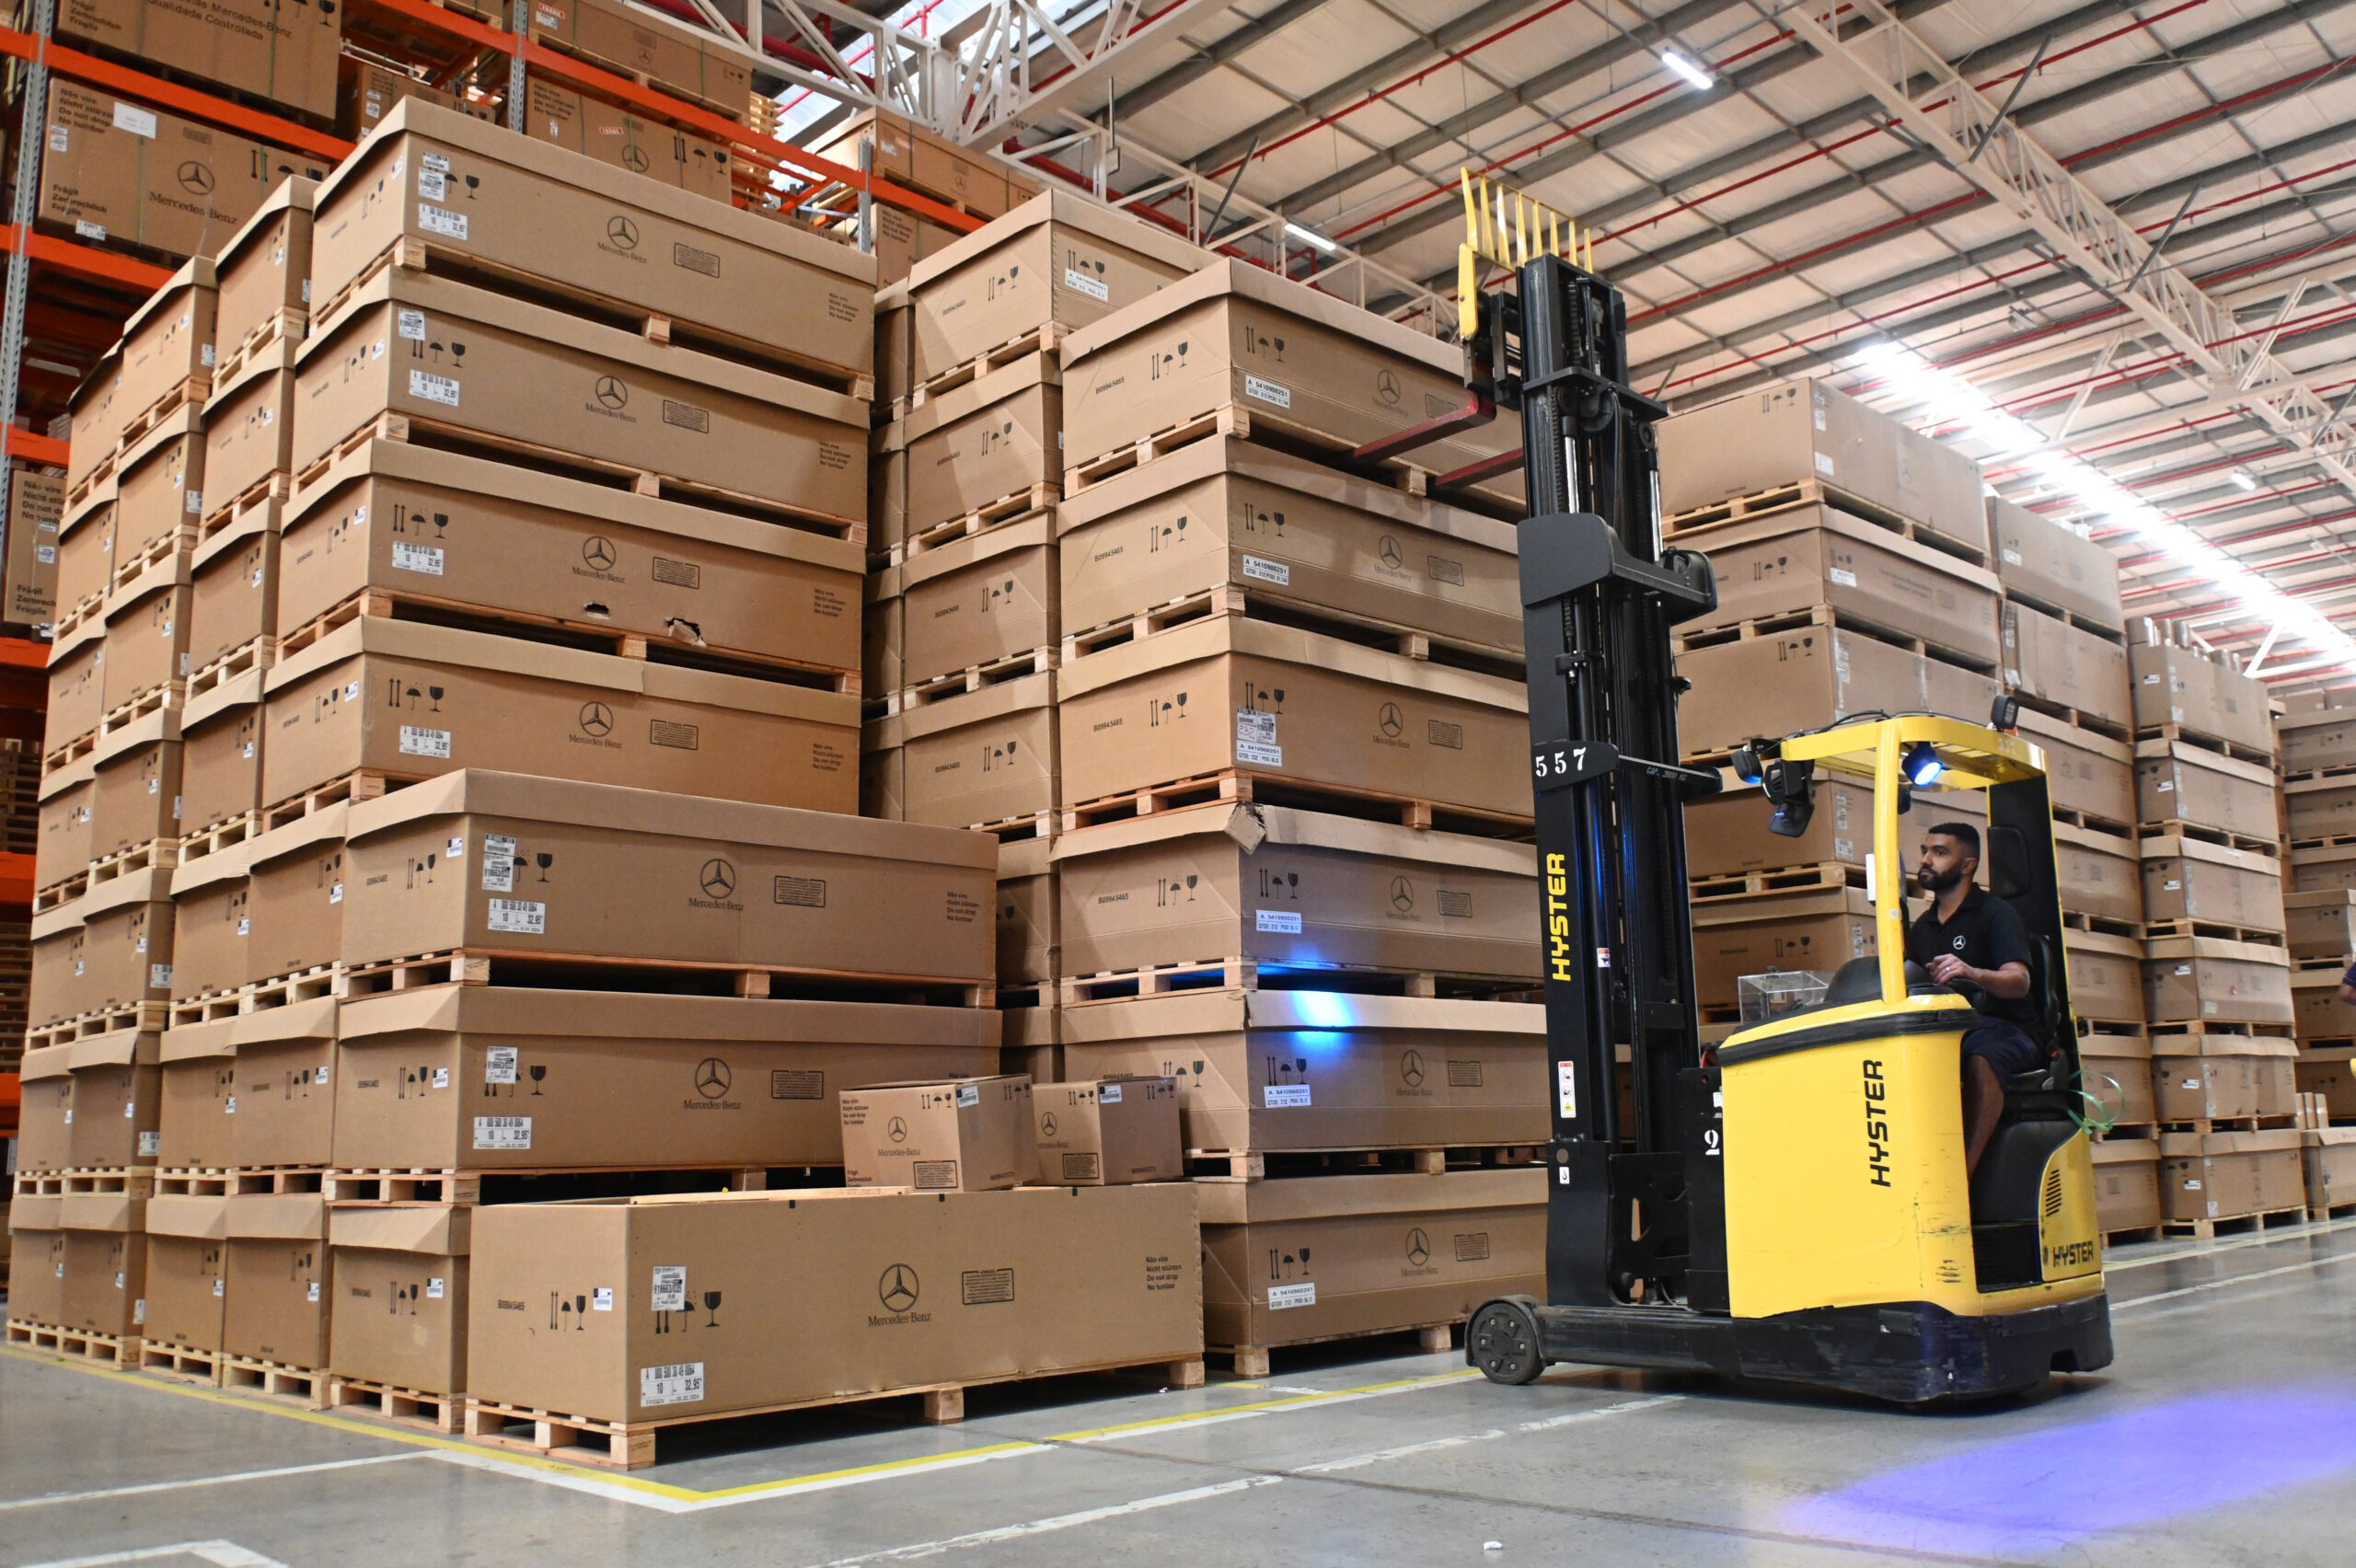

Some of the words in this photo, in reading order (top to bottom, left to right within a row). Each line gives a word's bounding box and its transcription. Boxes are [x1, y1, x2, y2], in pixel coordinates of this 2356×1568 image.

[205, 14, 264, 40] Controlada
[585, 403, 637, 423] Mercedes-Benz
[572, 566, 626, 583] Mercedes-Benz
[569, 734, 623, 750] Mercedes-Benz
[1535, 746, 1586, 778] 557
[688, 897, 745, 912] Mercedes-Benz
[1546, 853, 1571, 982] HYSTER
[684, 1099, 742, 1110] Mercedes-Benz
[1863, 1059, 1891, 1187] HYSTER
[877, 1147, 921, 1157] Mercedes-Benz
[2052, 1240, 2095, 1268] HYSTER
[868, 1312, 932, 1327] Mercedes-Benz
